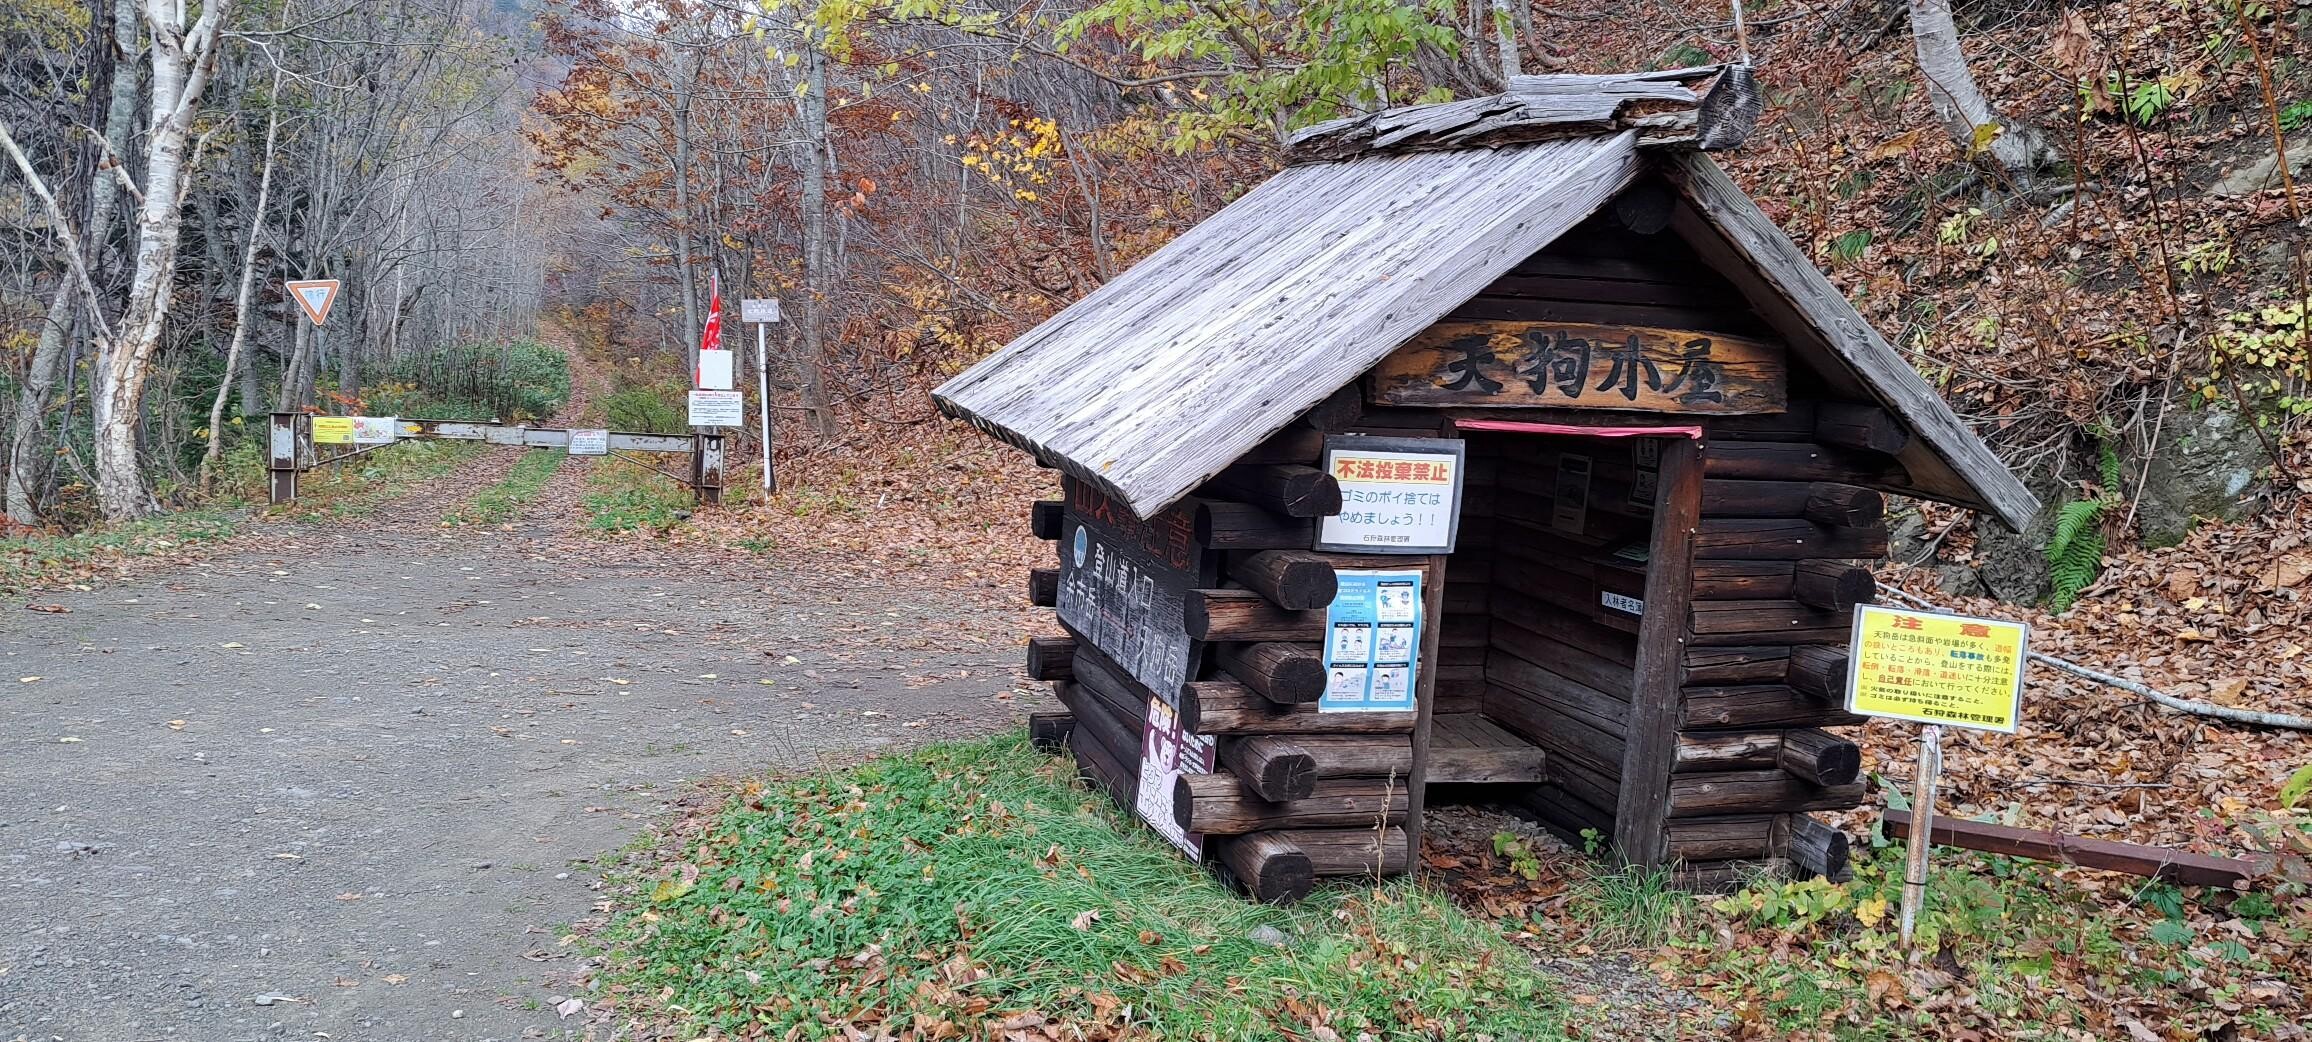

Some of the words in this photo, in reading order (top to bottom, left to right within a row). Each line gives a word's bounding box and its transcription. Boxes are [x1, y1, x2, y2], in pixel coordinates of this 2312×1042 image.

[1441, 330, 1724, 404] 天狗小屋
[1336, 459, 1448, 482] 不法投棄禁止
[1341, 489, 1441, 505] ゴミのポイ捨ては
[1066, 571, 1097, 621] 余市岳
[1093, 542, 1154, 610] 登山道入口
[1137, 625, 1178, 687] 天狗岳
[1922, 708, 2005, 724] 石狩森林管理署
